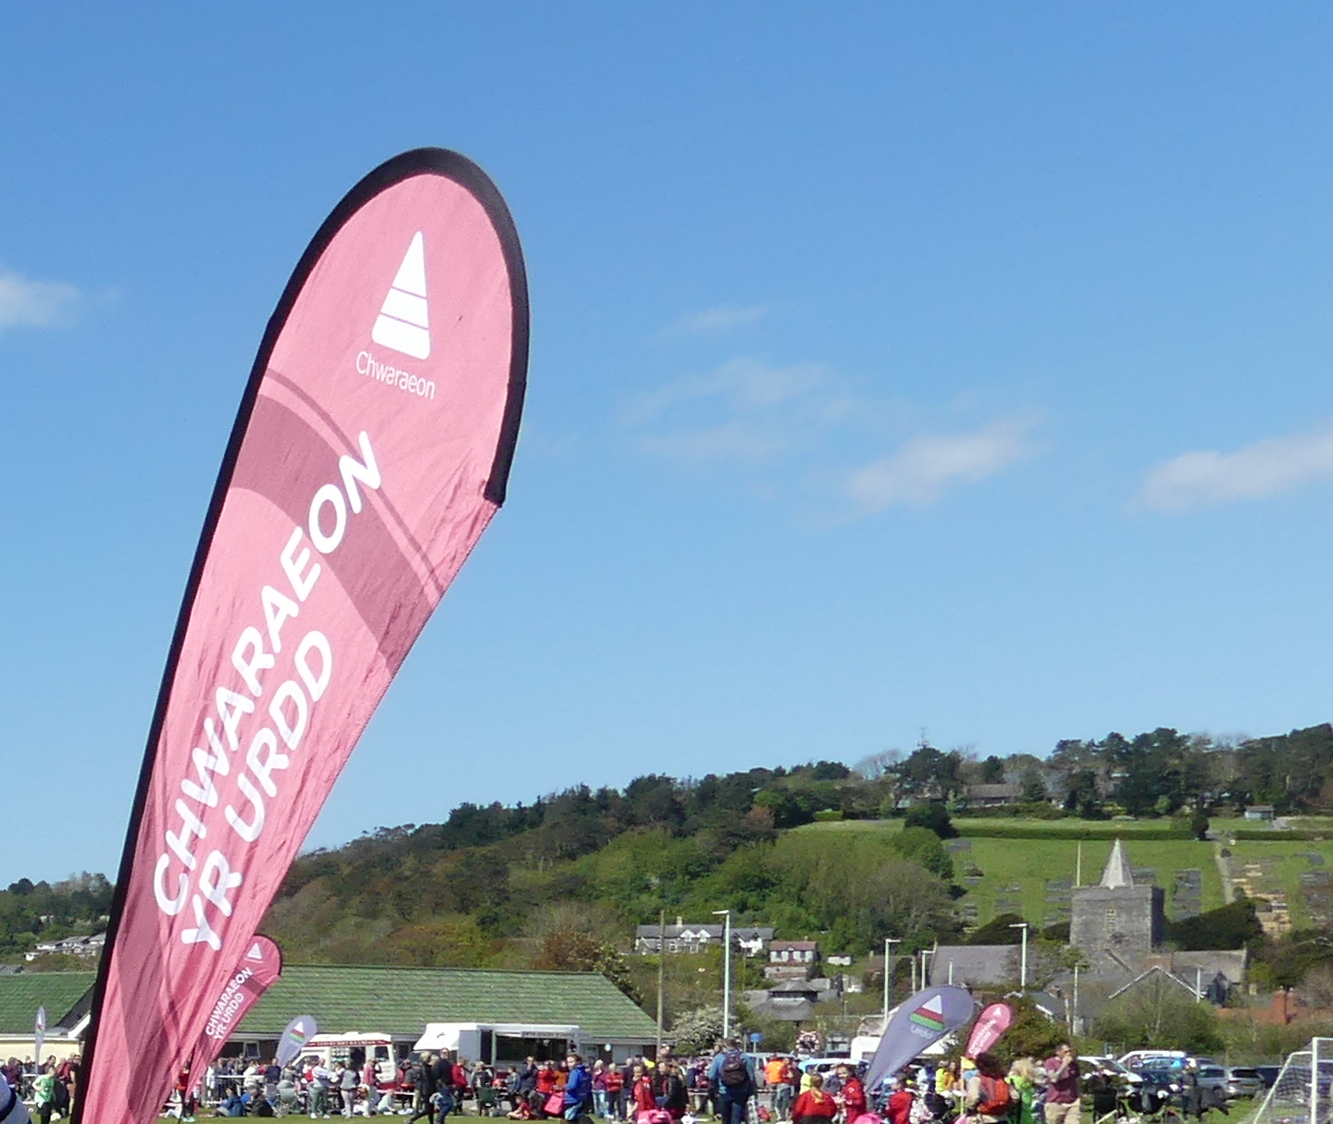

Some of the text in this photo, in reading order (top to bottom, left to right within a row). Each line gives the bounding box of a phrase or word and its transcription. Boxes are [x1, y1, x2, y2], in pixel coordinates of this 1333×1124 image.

[355, 350, 436, 400] Chwaraeon
[153, 430, 382, 917] CHWARAEON
[180, 630, 333, 951] YR URDD
[205, 966, 253, 1036] CHWARAEON
[222, 993, 244, 1024] URDD
